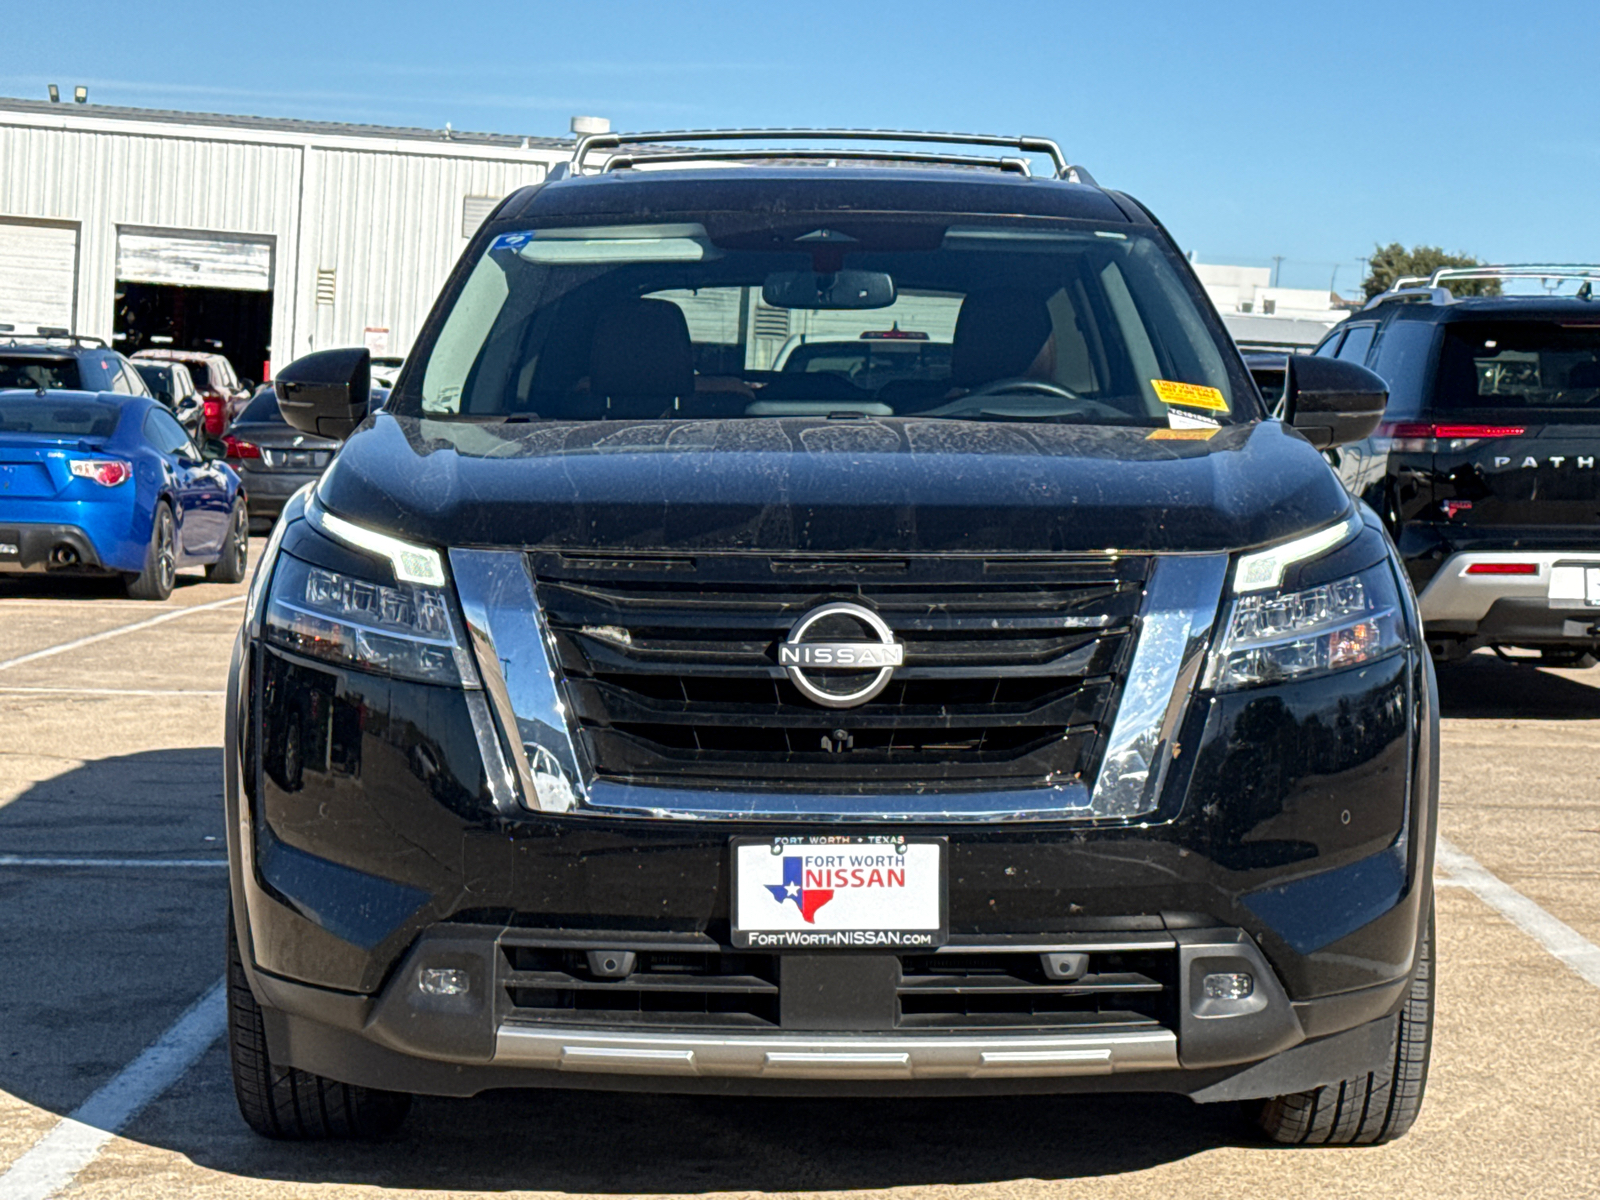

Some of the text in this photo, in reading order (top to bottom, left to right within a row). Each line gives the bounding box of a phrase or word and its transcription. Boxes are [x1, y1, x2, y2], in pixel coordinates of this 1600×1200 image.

[1157, 380, 1217, 394] THIS VEHICLE
[1494, 456, 1594, 468] PATH
[781, 647, 899, 663] NISSAN
[774, 835, 905, 845] FORT WORTH TEXAS
[805, 855, 906, 867] FORT WORTH
[805, 868, 906, 888] NISSAN
